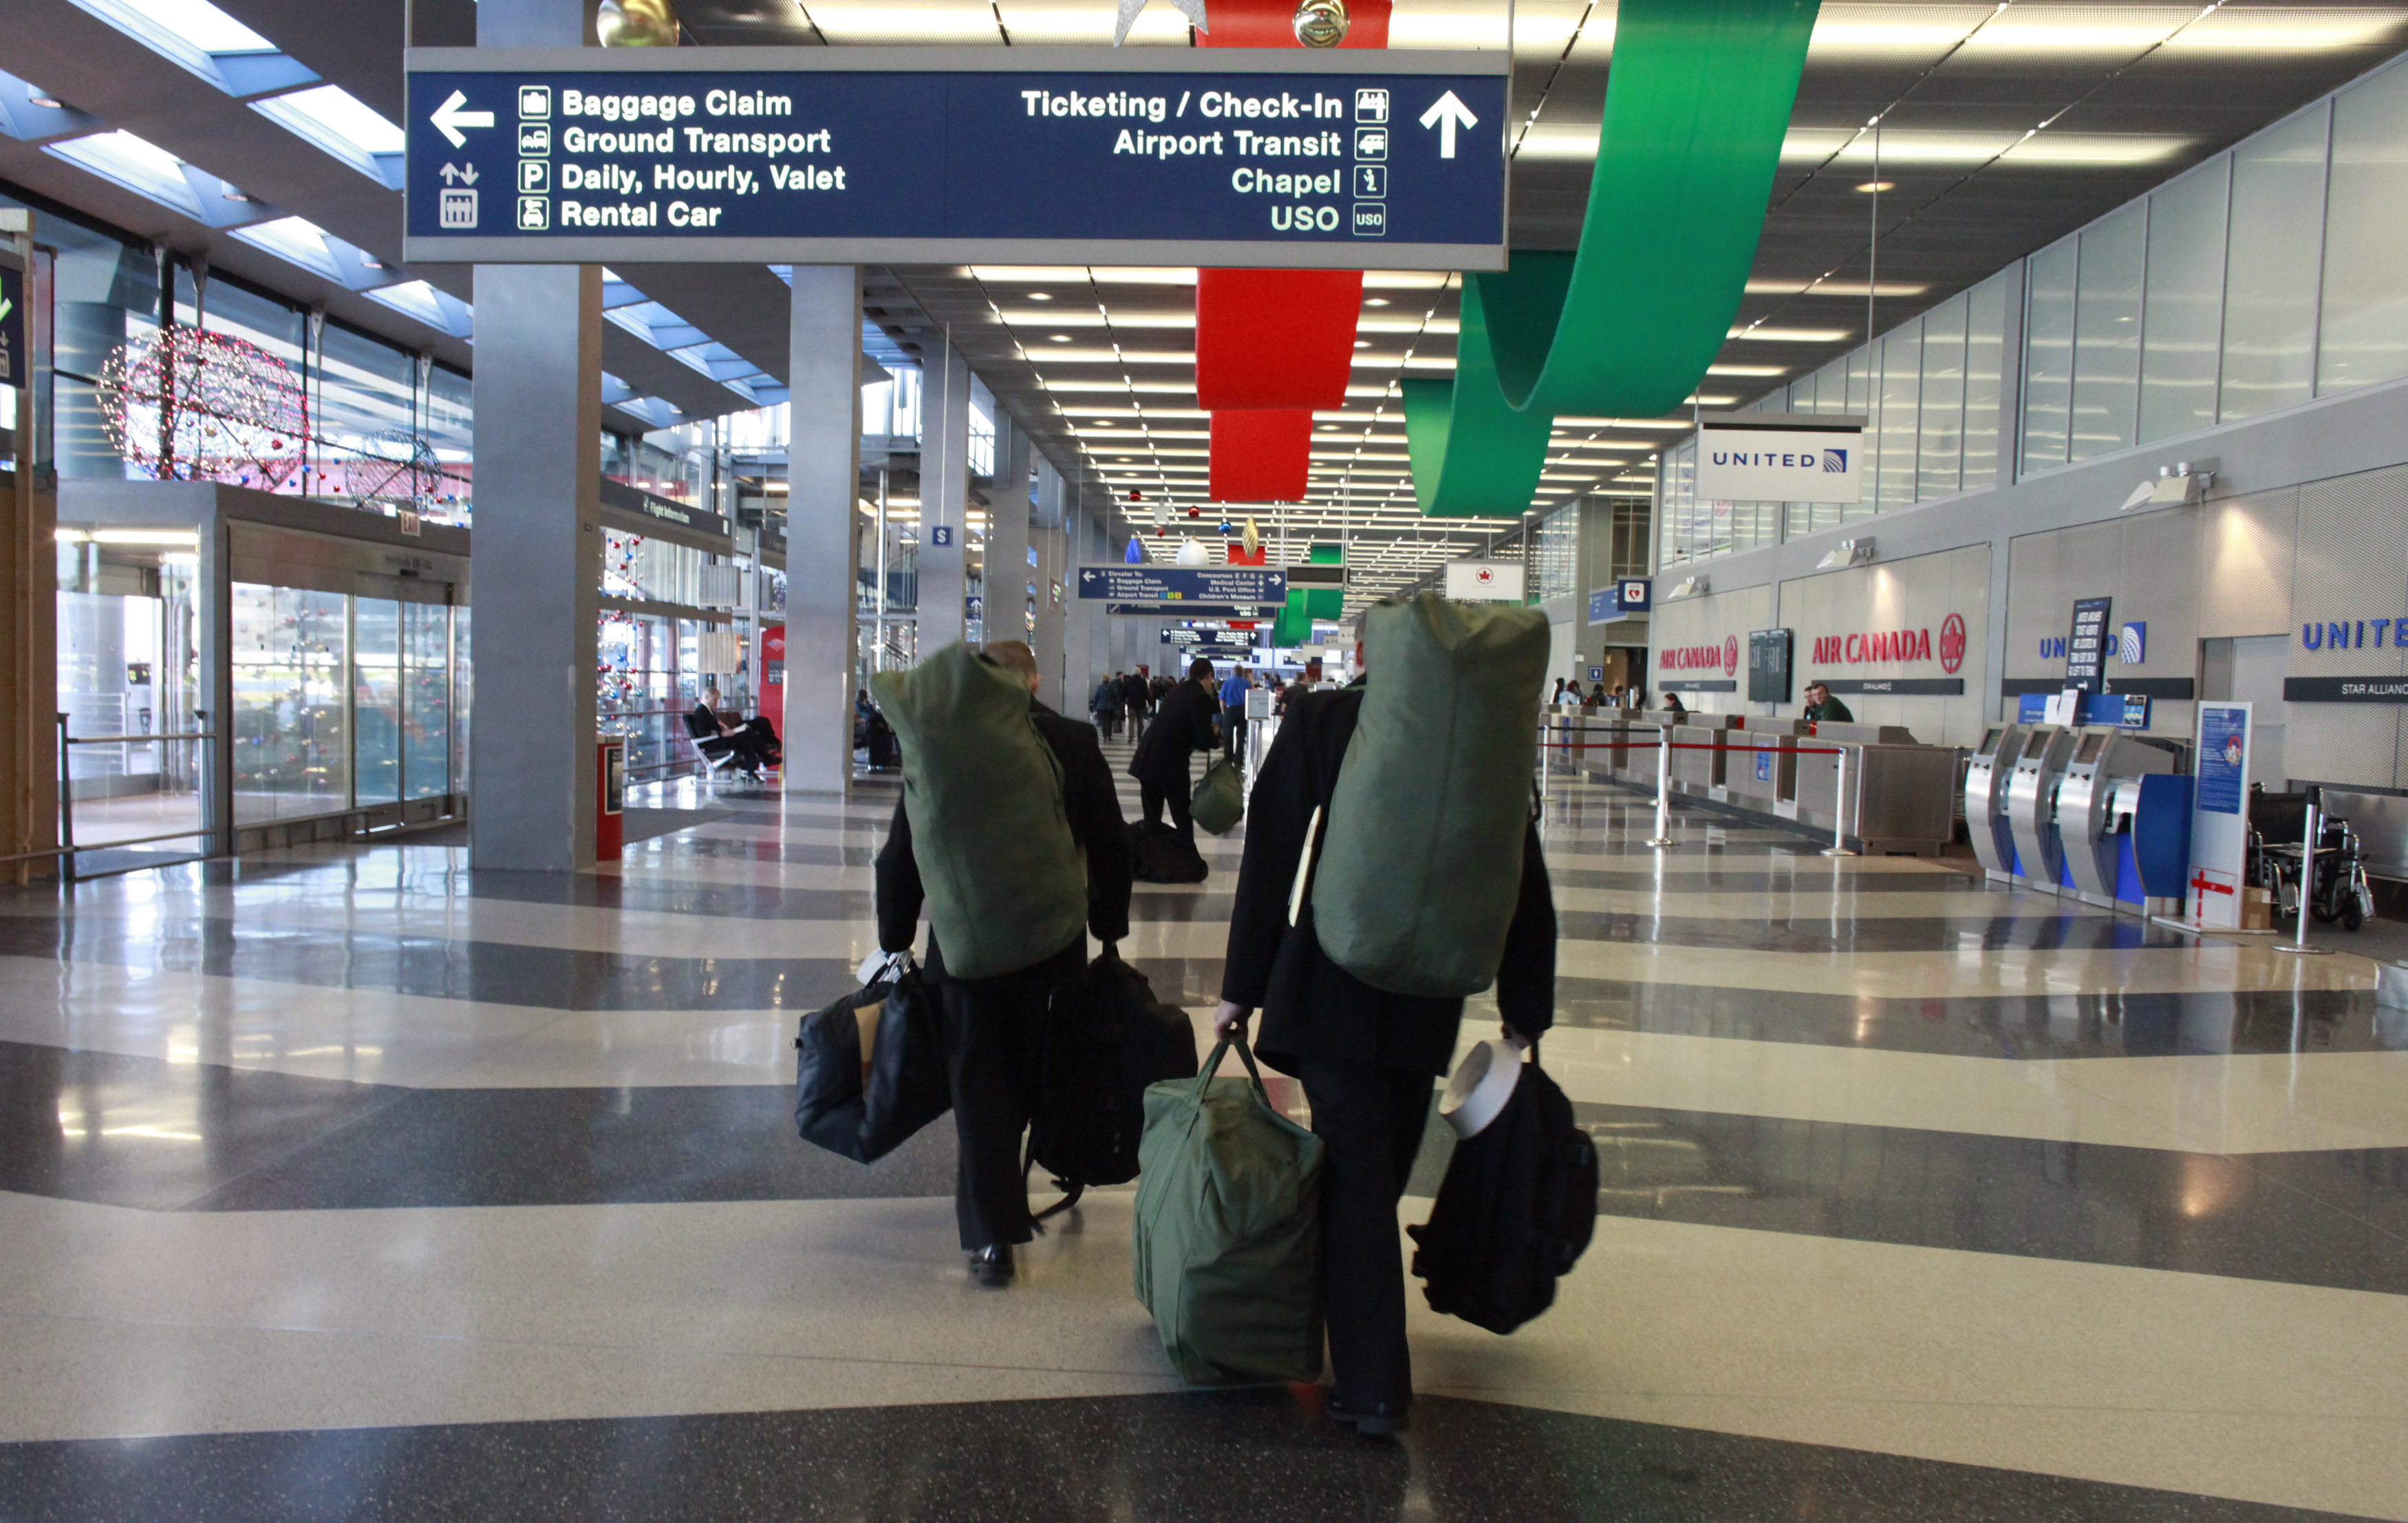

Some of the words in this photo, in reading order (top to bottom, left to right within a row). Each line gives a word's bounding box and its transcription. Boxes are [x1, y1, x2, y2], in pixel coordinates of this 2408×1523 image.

[563, 89, 696, 122] Baggage
[705, 89, 792, 116] Claim
[1021, 90, 1166, 123] Ticketing
[1176, 90, 1191, 118] /
[1199, 91, 1342, 118] Check-In
[563, 126, 674, 153] Ground
[683, 127, 831, 158] Transport
[1113, 129, 1224, 160] Airport
[1233, 129, 1342, 156] Transit
[561, 163, 643, 195] Daily,
[654, 164, 759, 195] Hourly,
[769, 164, 846, 190] Valet
[1232, 167, 1341, 199] Chapel
[561, 200, 657, 227] Rental
[667, 200, 722, 227] Car
[1271, 206, 1340, 231] USO
[1356, 213, 1383, 226] USO
[1713, 452, 1815, 467] UNITED
[404, 512, 418, 533] EXIT
[649, 501, 665, 518] Flight
[1659, 649, 1676, 669] AIR
[1677, 645, 1721, 669] CANADA
[1812, 635, 1842, 665] AIR
[1845, 628, 1931, 664] CANADA
[2341, 684, 2367, 695] STAR
[2367, 684, 2408, 695] ALLIANC
